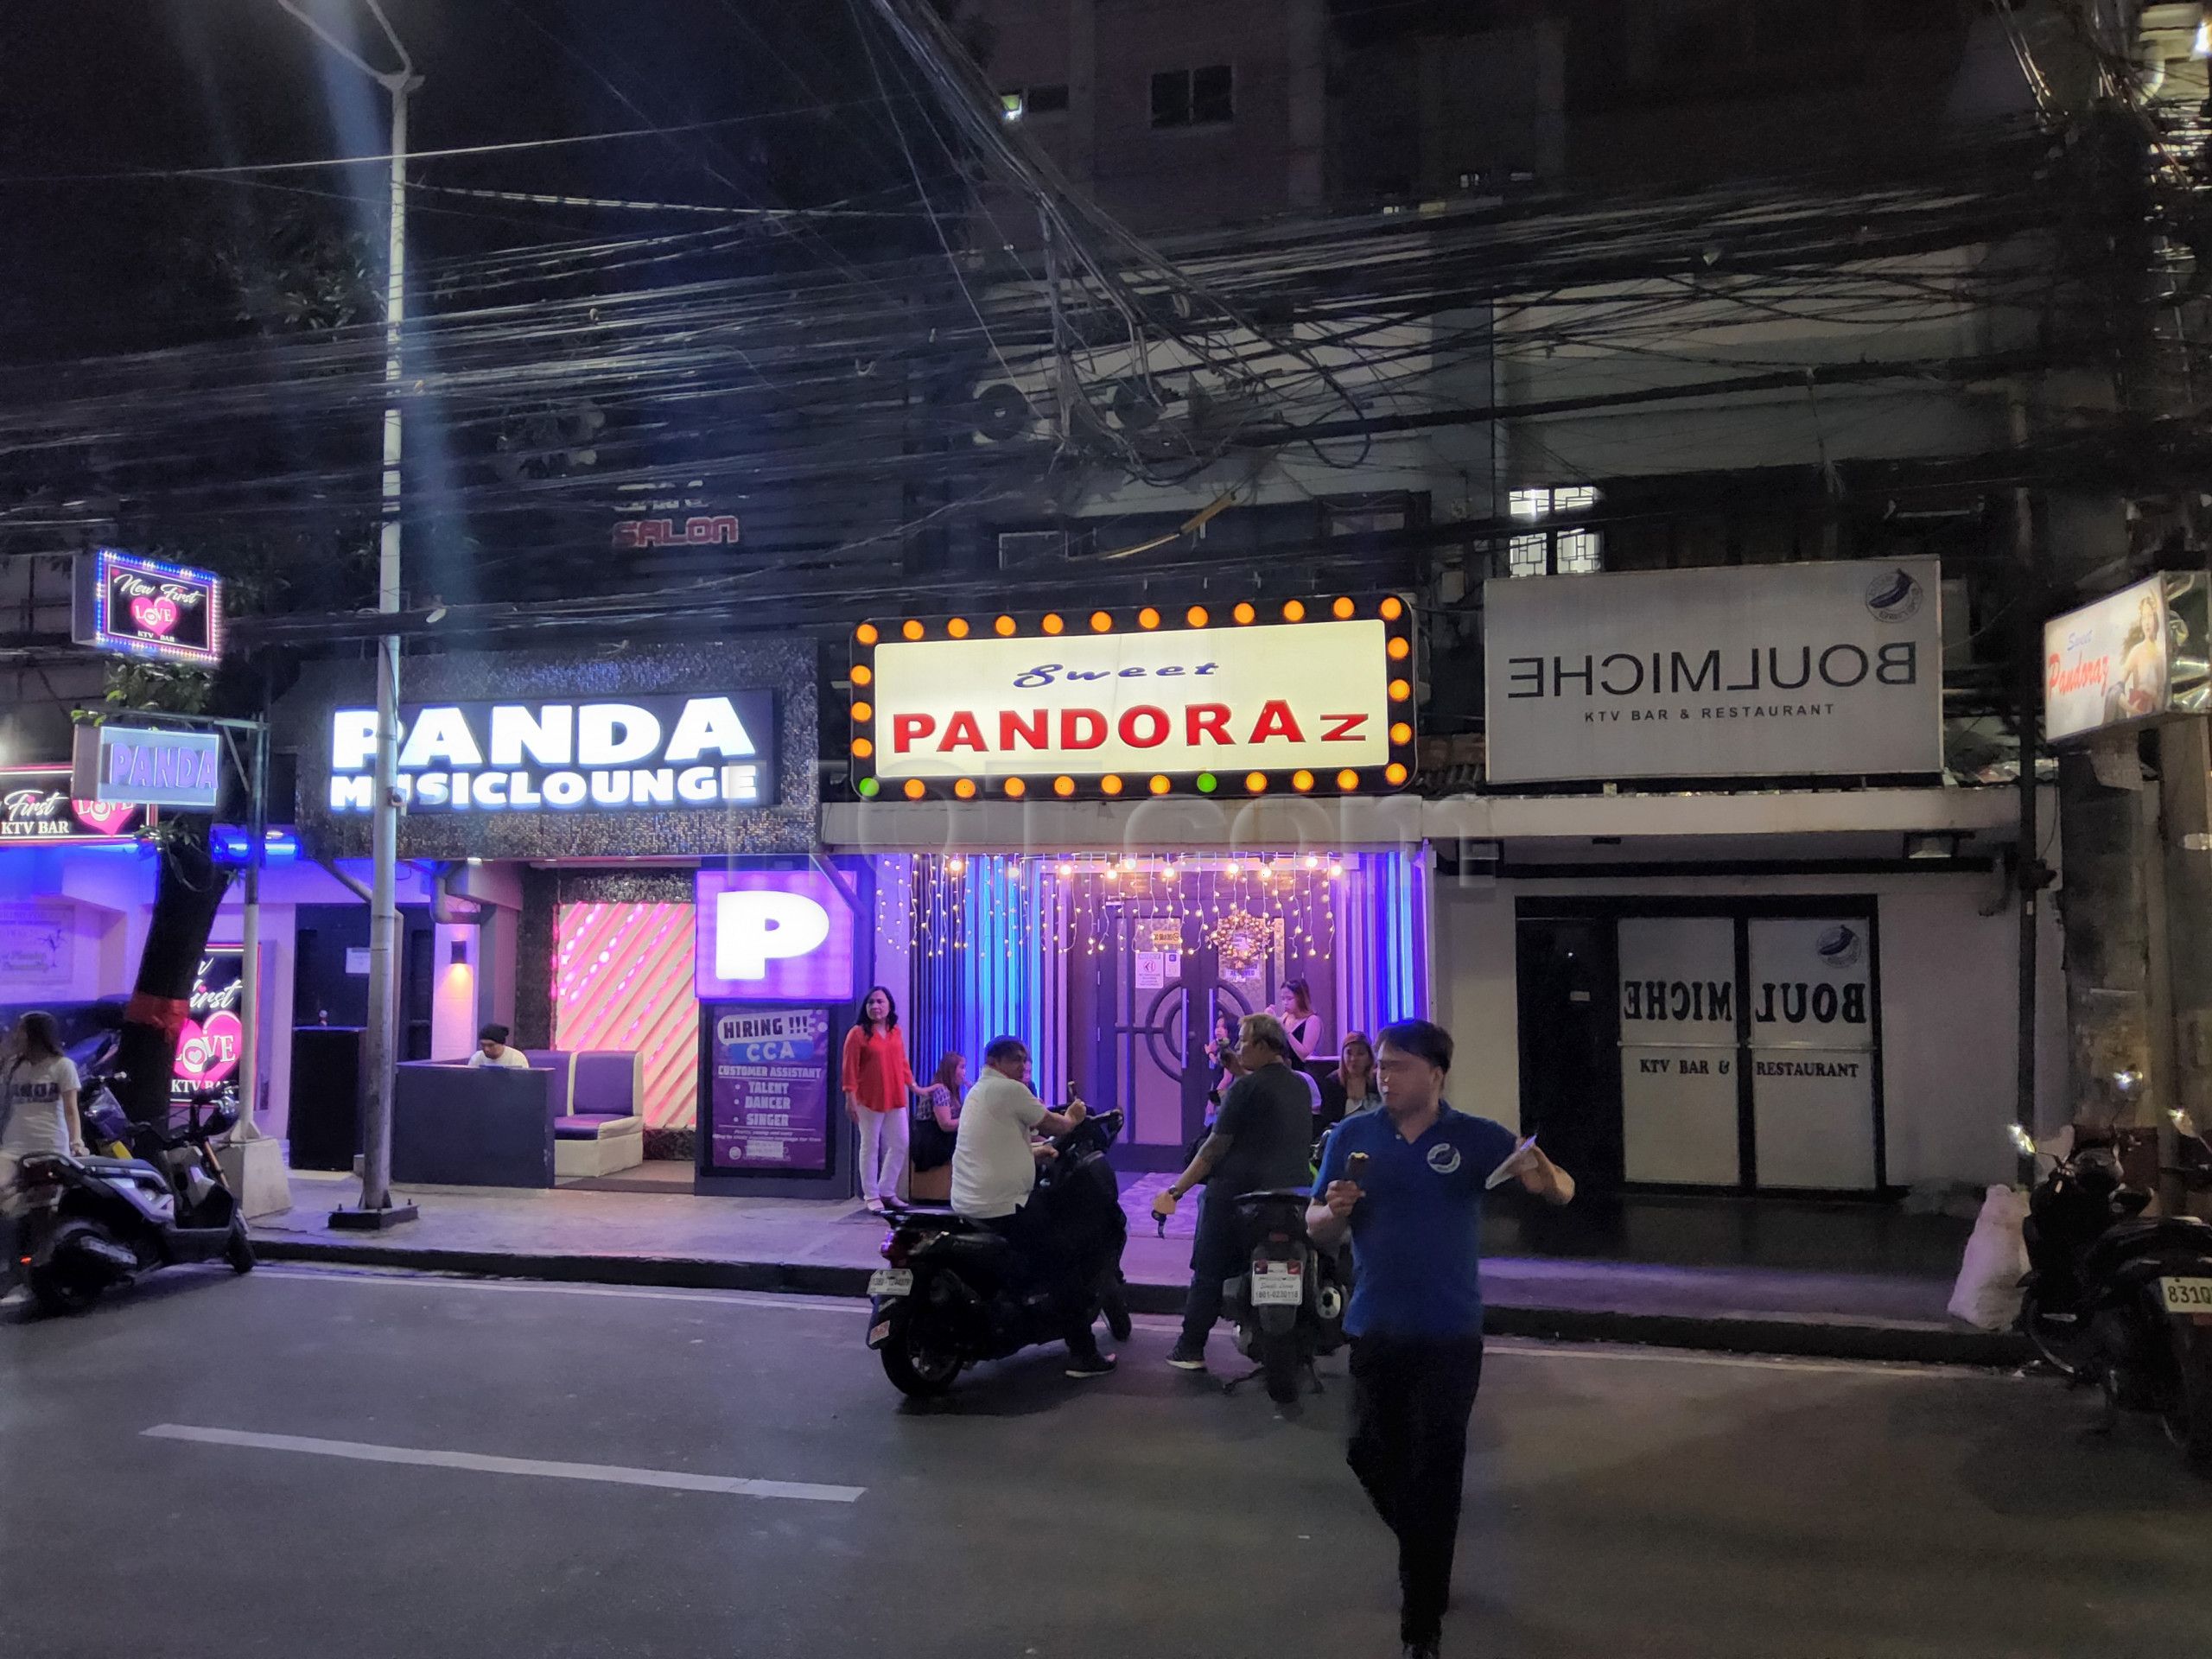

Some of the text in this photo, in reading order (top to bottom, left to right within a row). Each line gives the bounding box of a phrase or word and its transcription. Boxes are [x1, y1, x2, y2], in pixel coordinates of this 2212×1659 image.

[113, 574, 206, 603] New First
[135, 605, 174, 626] LOVE
[1013, 662, 1219, 689] Sweet
[1585, 703, 1835, 723] KTV BAR & RESTAURANT
[332, 696, 757, 770] PANDA
[110, 742, 219, 789] PANDA
[4, 790, 69, 821] First
[2, 821, 69, 835] KTV BAR
[715, 890, 830, 980] P
[723, 1018, 783, 1039] HIRING
[175, 1035, 236, 1073] OVE
[746, 1041, 796, 1062] CCA
[718, 1065, 822, 1078] CUSTOMER ASSISTANT
[1640, 1059, 1859, 1077] KTV BAR & RESTAURANT
[748, 1081, 790, 1094] TALENT
[745, 1096, 791, 1109] DANCER
[746, 1113, 790, 1126] SINGER
